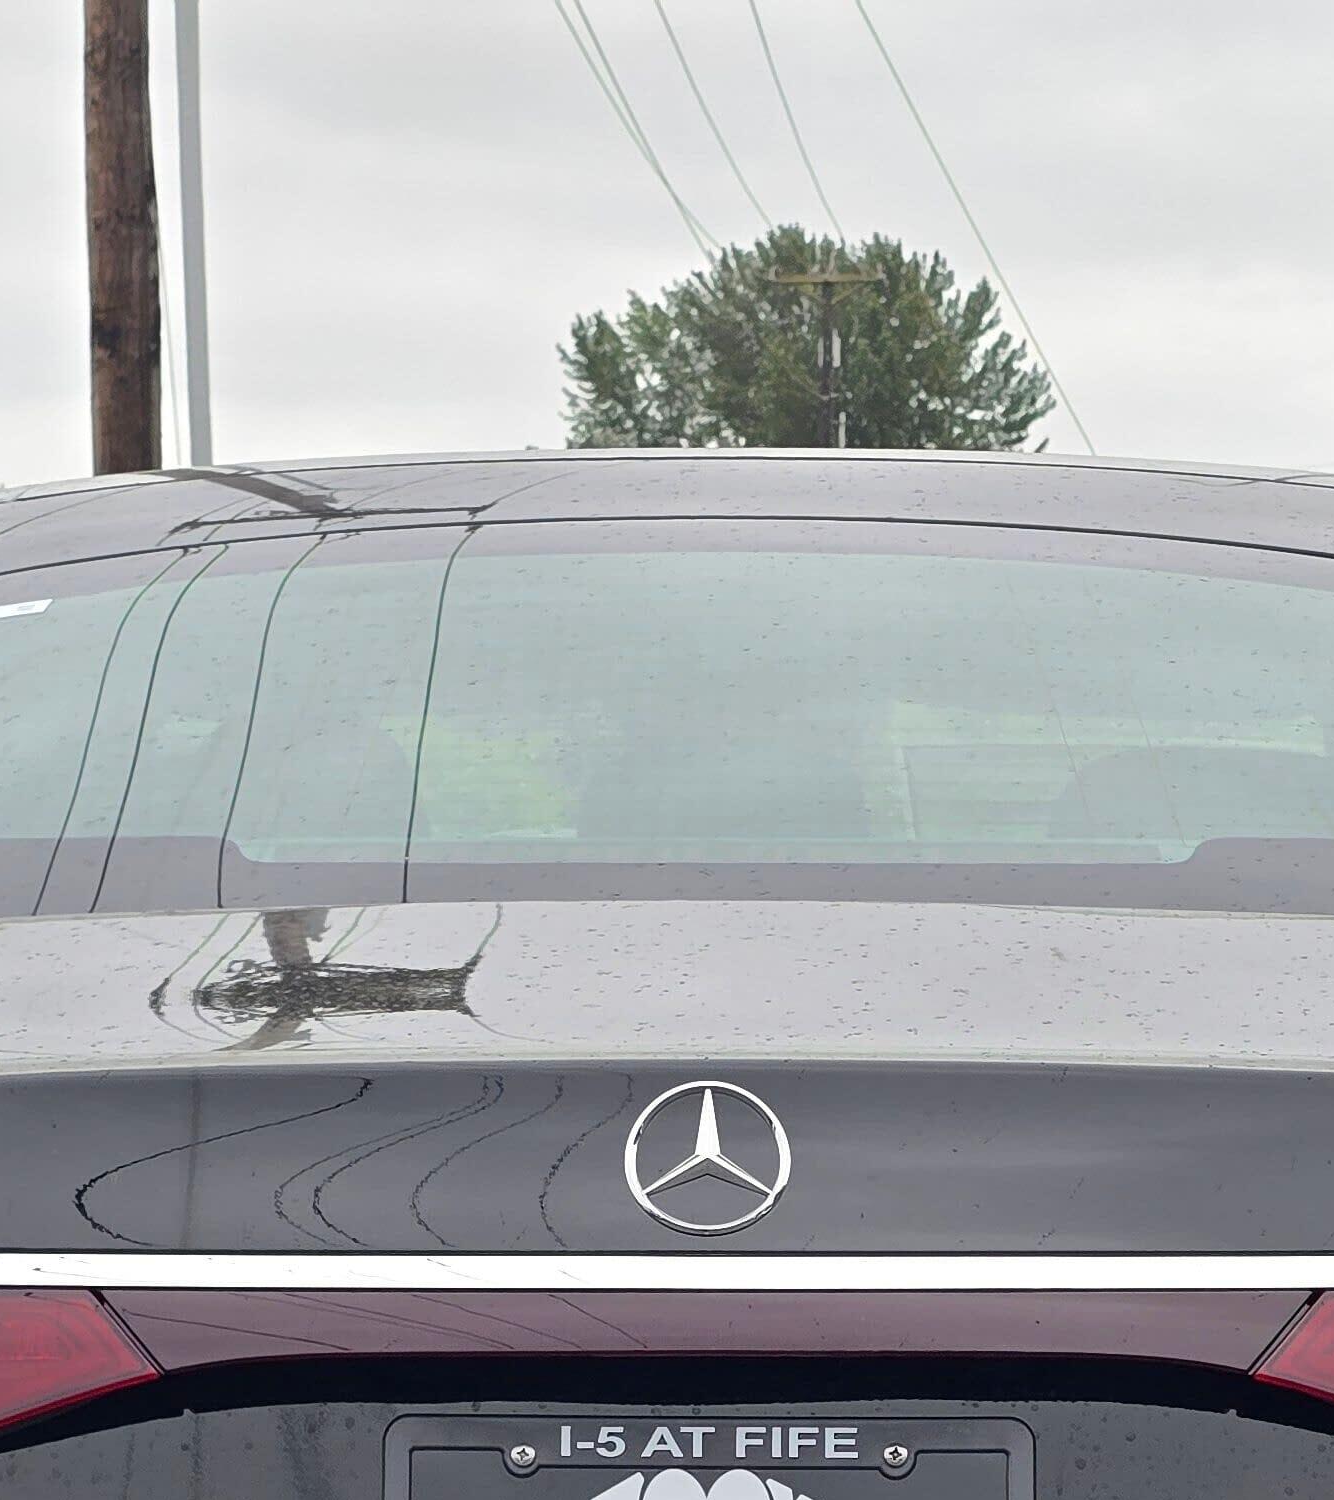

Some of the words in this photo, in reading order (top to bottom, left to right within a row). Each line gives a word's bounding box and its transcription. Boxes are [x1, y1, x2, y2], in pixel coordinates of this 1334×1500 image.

[560, 1425, 626, 1458] I-5
[641, 1426, 716, 1458] AT
[735, 1426, 859, 1459] FIFE
